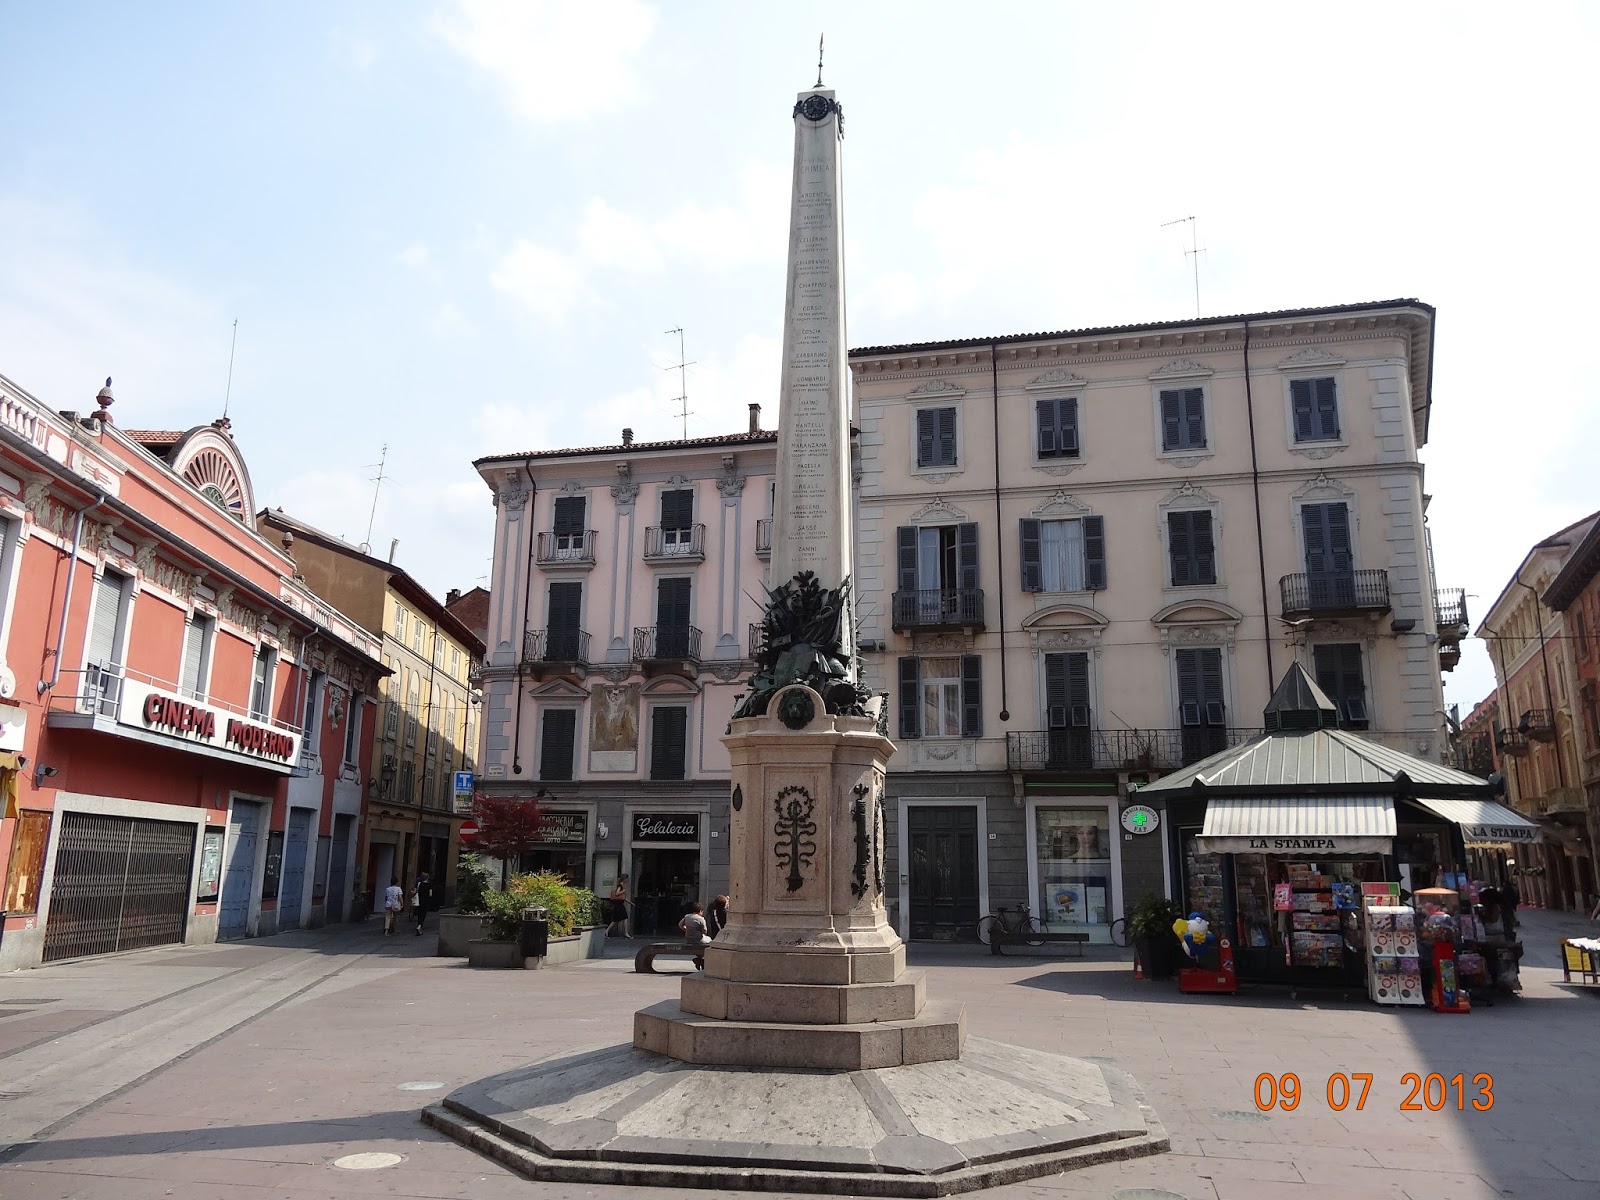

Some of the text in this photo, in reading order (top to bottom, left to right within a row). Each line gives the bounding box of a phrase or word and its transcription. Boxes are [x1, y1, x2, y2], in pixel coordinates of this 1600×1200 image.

[144, 693, 295, 760] CINEMA MODERNO
[636, 817, 695, 838] Gelateria
[1473, 826, 1533, 839] LA STAMPA
[1249, 839, 1336, 849] LA STAMPA
